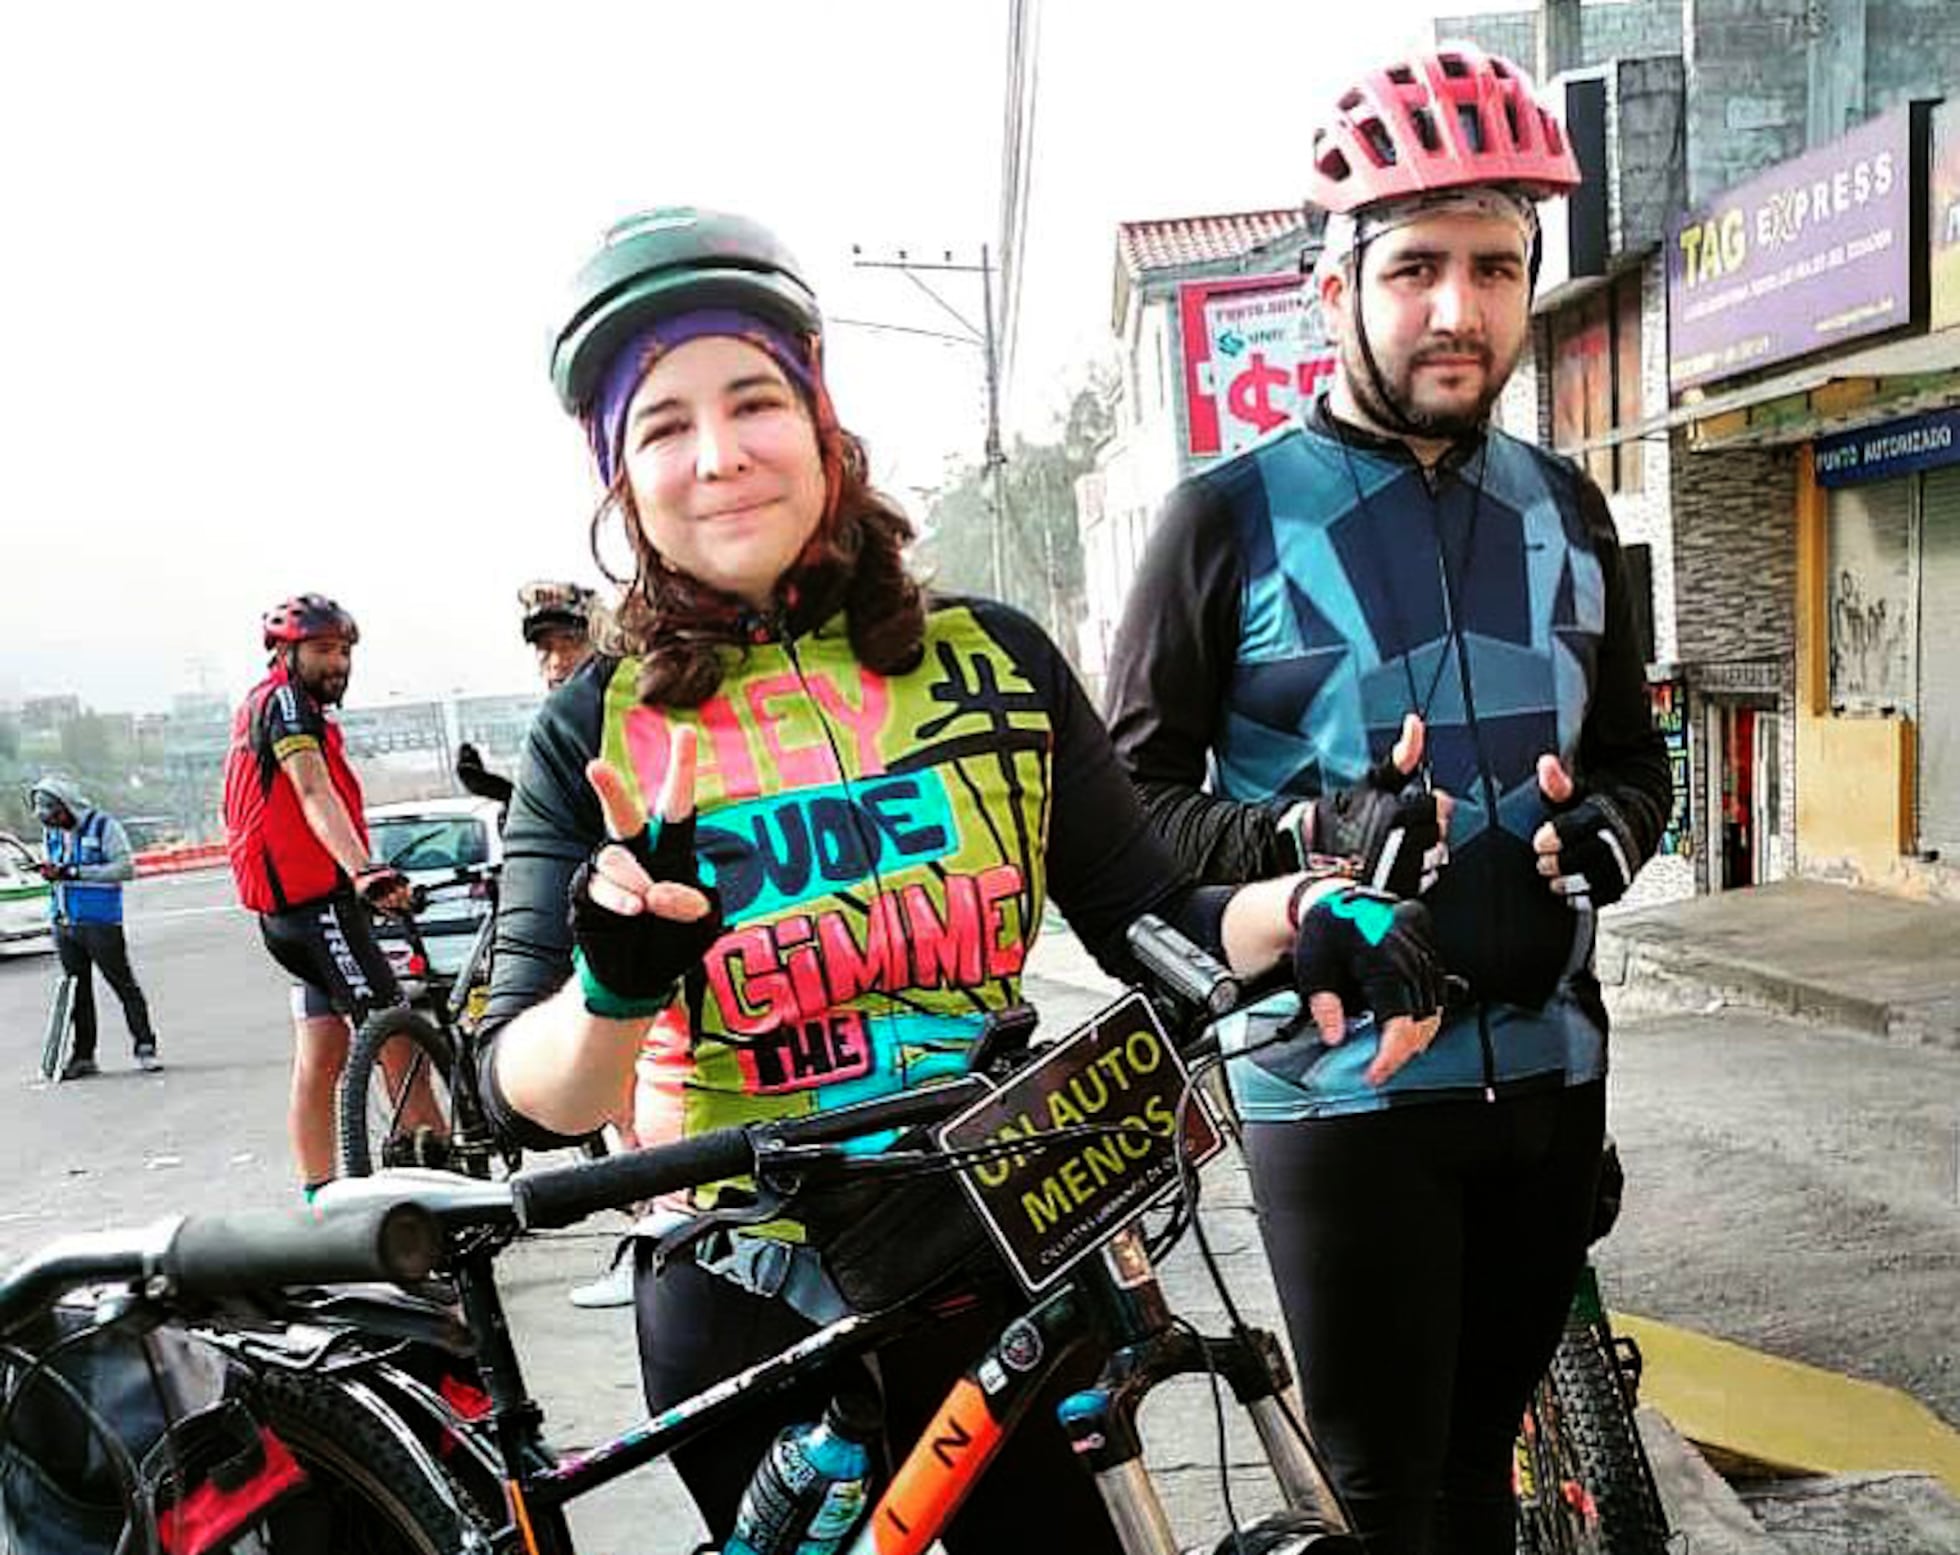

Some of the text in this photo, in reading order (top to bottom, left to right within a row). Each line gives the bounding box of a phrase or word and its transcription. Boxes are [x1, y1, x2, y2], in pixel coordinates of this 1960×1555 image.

[1679, 207, 1746, 288] TAG
[1756, 151, 1893, 246] EXPRESS
[1863, 426, 1952, 464] AUTORIZADO
[697, 781, 946, 911] DUDE
[748, 1016, 862, 1088] THE
[1047, 1030, 1161, 1131] AUTO
[1021, 1095, 1177, 1234] MENOS
